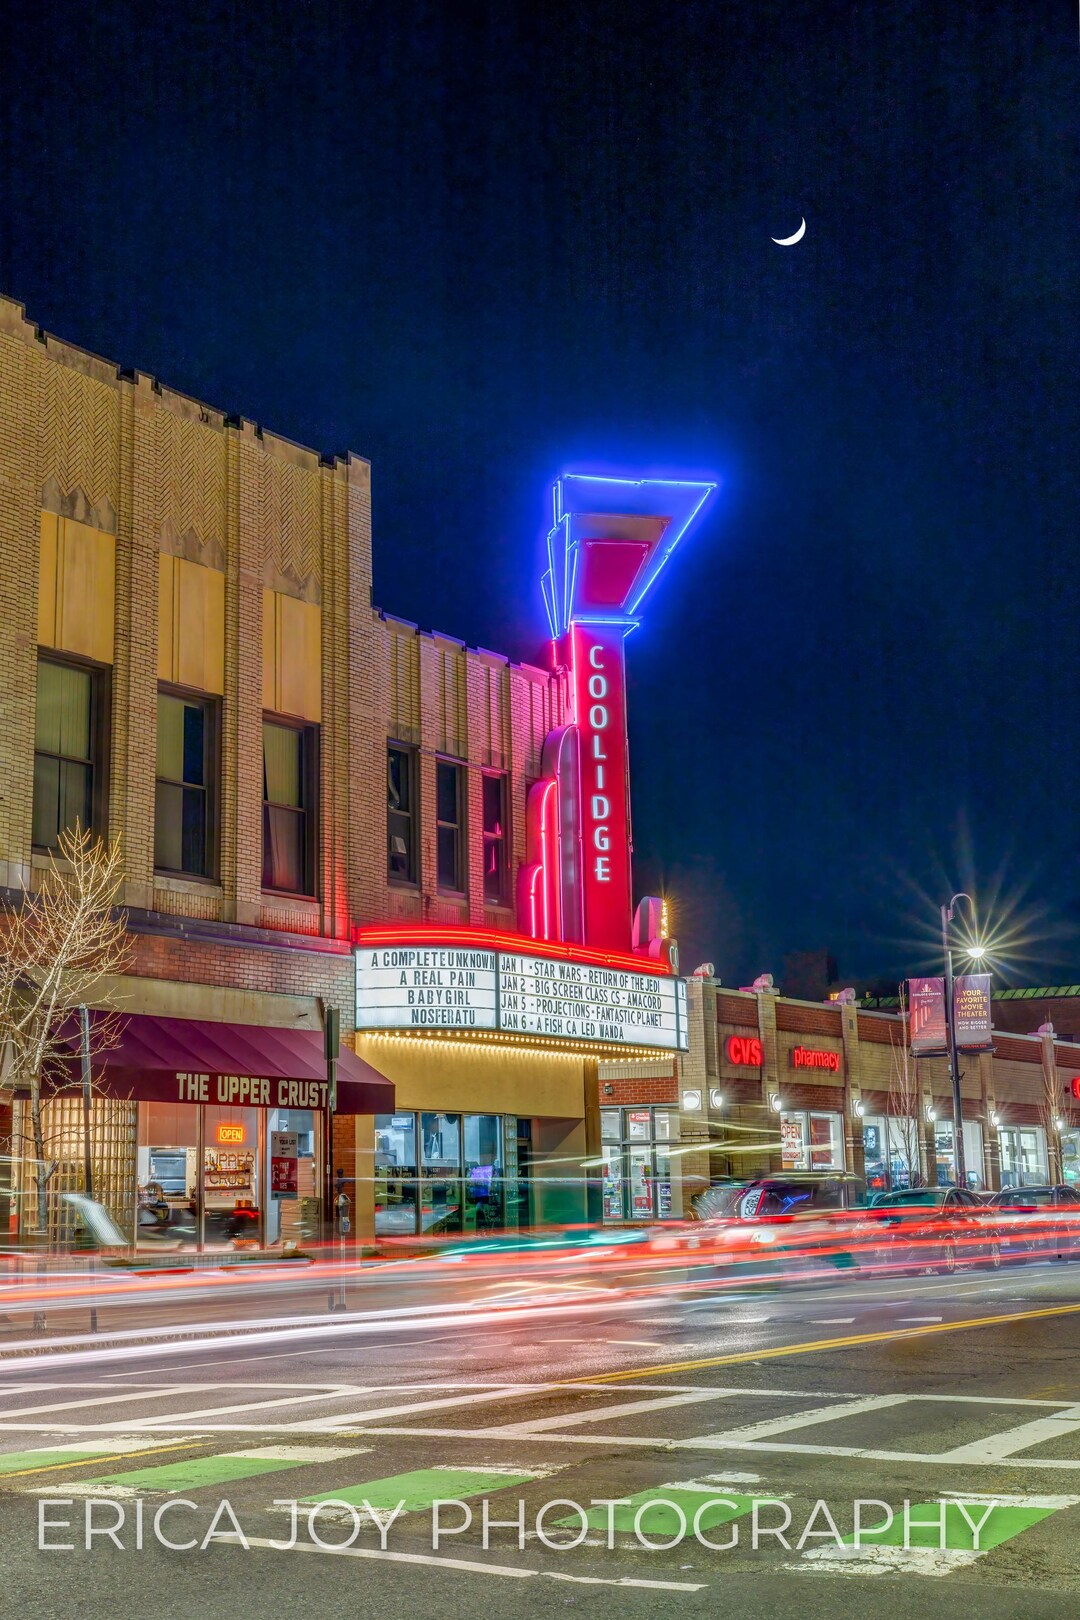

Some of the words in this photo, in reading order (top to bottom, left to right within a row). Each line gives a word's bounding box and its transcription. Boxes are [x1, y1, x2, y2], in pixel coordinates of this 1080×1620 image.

[589, 645, 611, 881] COOLIDGE
[372, 953, 378, 966] A
[400, 971, 407, 985] A
[414, 971, 443, 985] REAL
[450, 971, 474, 986] PAIN
[502, 957, 516, 972] JAN
[521, 960, 523, 973] 1
[535, 962, 555, 977] STAR
[559, 965, 581, 981] WARS
[589, 970, 617, 986] RETURN
[620, 975, 628, 988] OF
[631, 977, 644, 990] THE
[645, 978, 659, 993] JEDI
[408, 990, 470, 1005] BABYGIRL
[502, 976, 517, 990] JAN
[521, 978, 525, 991] 2
[535, 980, 549, 994] BIG
[553, 982, 583, 999] SCREEN
[627, 993, 661, 1009] AMACORD
[501, 994, 517, 1009] JAN
[522, 997, 525, 1010] 5
[537, 999, 590, 1018] PROJECTIONS
[412, 1009, 475, 1024] NOSFERATU
[502, 1013, 518, 1028] JAN
[522, 1015, 526, 1029] 6
[537, 1017, 542, 1031] A
[545, 1018, 562, 1033] FISH
[599, 1024, 624, 1039] WANDA
[729, 1036, 762, 1066] CVS
[794, 1046, 840, 1072] pharmacy
[176, 1073, 209, 1101] THE
[218, 1076, 270, 1104] UPPER
[278, 1080, 329, 1107] CRUST
[222, 1129, 241, 1140] OPEN
[782, 1126, 800, 1139] OPEN
[209, 1153, 254, 1167] UPPER
[209, 1173, 253, 1185] CRUST
